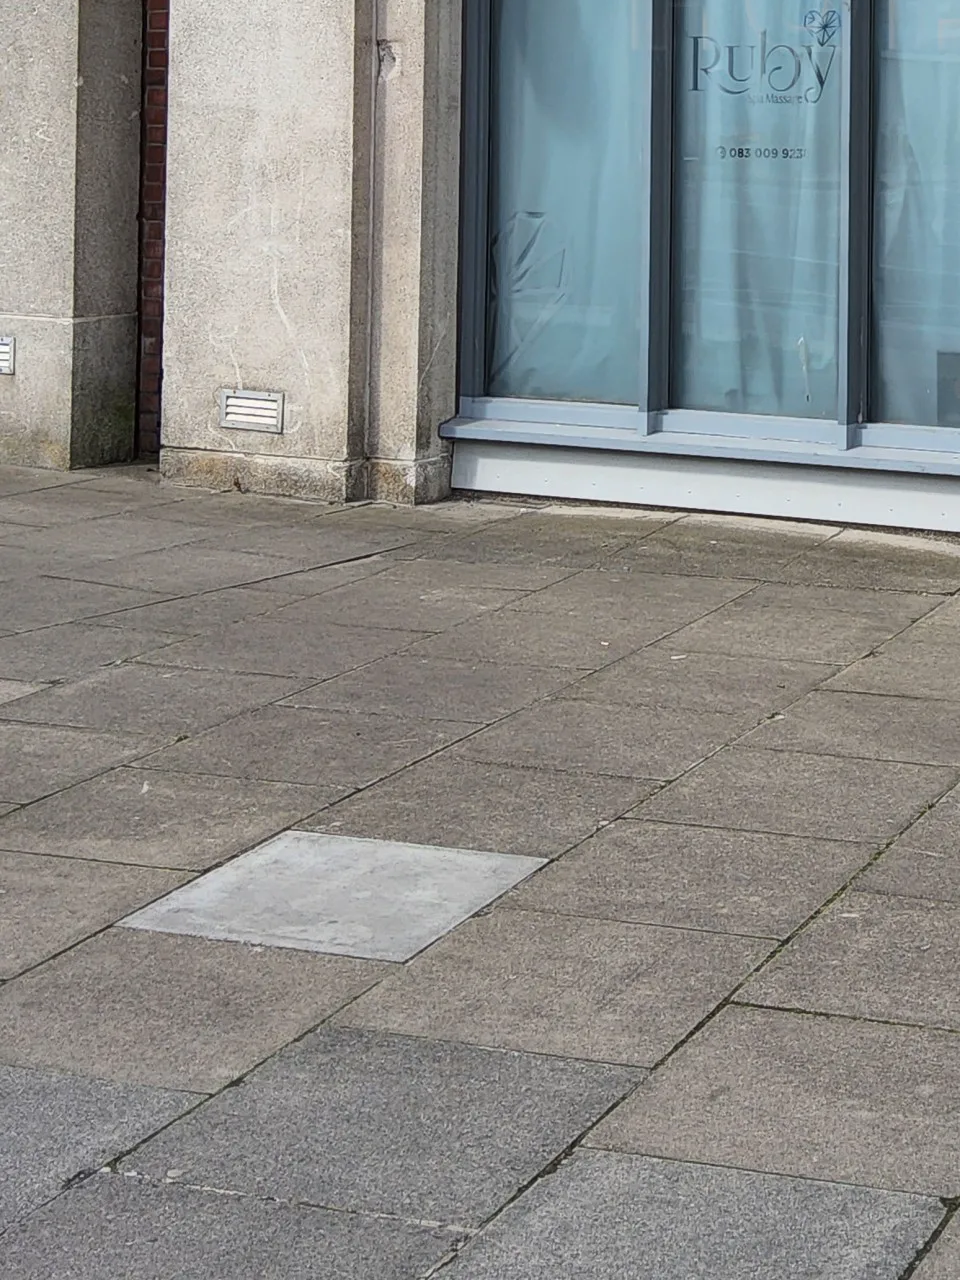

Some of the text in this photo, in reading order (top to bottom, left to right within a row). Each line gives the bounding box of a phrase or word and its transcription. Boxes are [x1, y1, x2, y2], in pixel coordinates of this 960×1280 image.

[688, 29, 836, 103] Ruby
[729, 148, 750, 158] 083
[755, 148, 778, 158] 009
